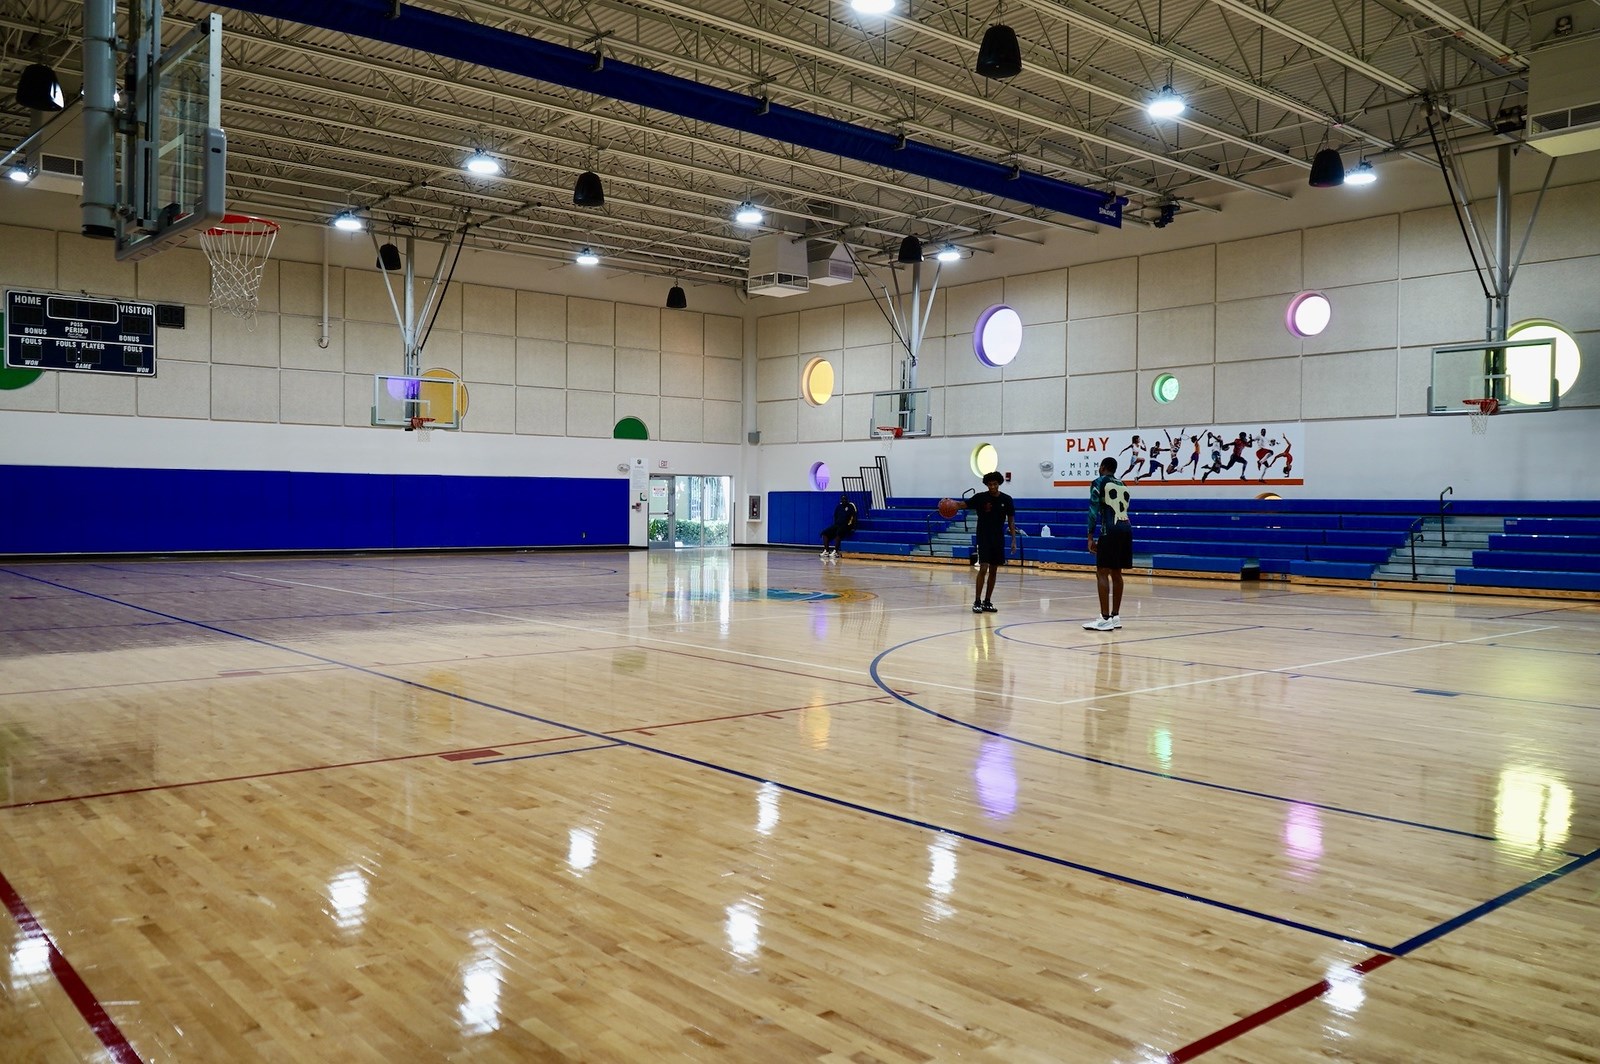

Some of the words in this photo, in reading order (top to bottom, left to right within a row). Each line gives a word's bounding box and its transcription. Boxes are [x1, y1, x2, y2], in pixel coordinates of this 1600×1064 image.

[14, 295, 42, 305] HOME
[120, 304, 152, 315] VISITOR
[24, 327, 47, 335] BONUS
[64, 326, 89, 335] PERIOD
[21, 337, 43, 346] FOULS
[118, 334, 140, 343] BONUS
[55, 340, 77, 348] FOULS
[81, 342, 105, 350] PLAYER
[123, 345, 143, 353] FOULS
[74, 362, 92, 370] GAME
[1066, 436, 1109, 453] PLAY
